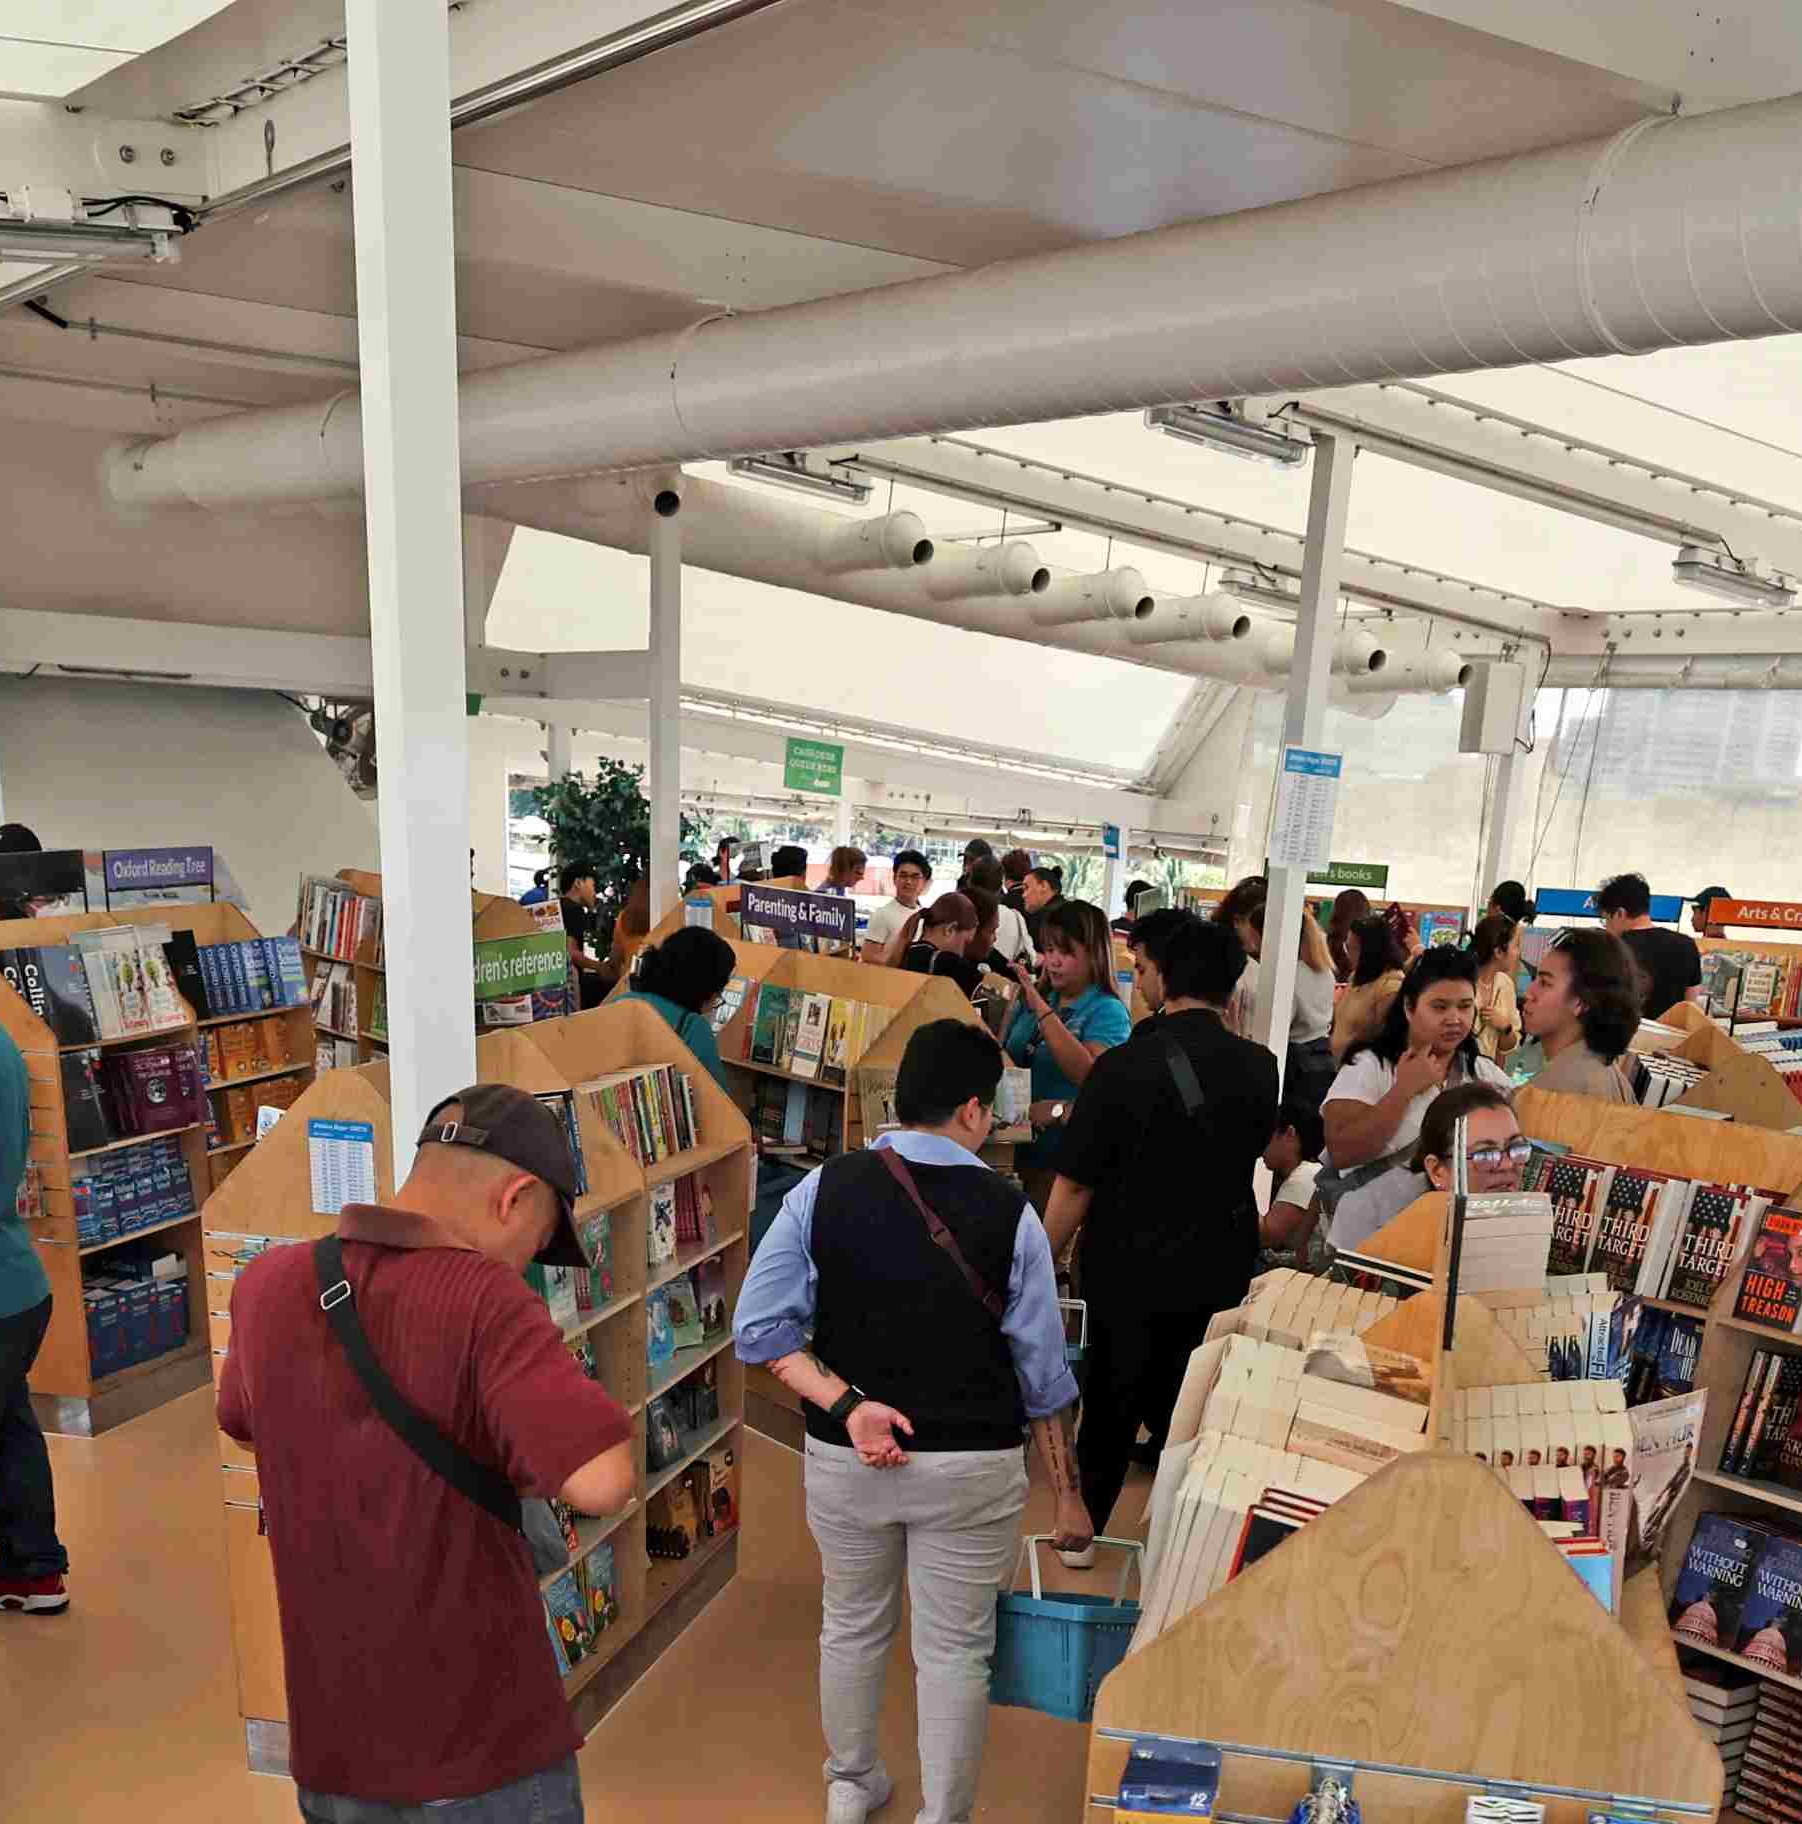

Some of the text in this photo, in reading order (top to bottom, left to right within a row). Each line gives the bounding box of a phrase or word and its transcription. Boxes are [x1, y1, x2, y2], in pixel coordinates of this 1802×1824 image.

[113, 858, 207, 880] Oxford Reading Tree
[1337, 867, 1372, 883] books
[747, 893, 847, 931] Parenting & Family
[1737, 904, 1769, 922] Arts
[1771, 907, 1782, 923] &
[473, 948, 564, 983] dren's reference
[24, 964, 45, 1017] Collin
[1550, 1225, 1591, 1247] ARGET
[1601, 1215, 1651, 1243] THIRD
[1597, 1232, 1647, 1259] TARGET
[1684, 1234, 1736, 1262] THIRD
[1678, 1252, 1731, 1279] TARGET
[1745, 1274, 1789, 1301] HIGH
[1740, 1295, 1798, 1323] TREASON
[1765, 1424, 1791, 1442] TAR
[1687, 1557, 1744, 1588] WARNING
[1690, 1546, 1748, 1577] WITHOUT
[1189, 1791, 1208, 1809] 12
